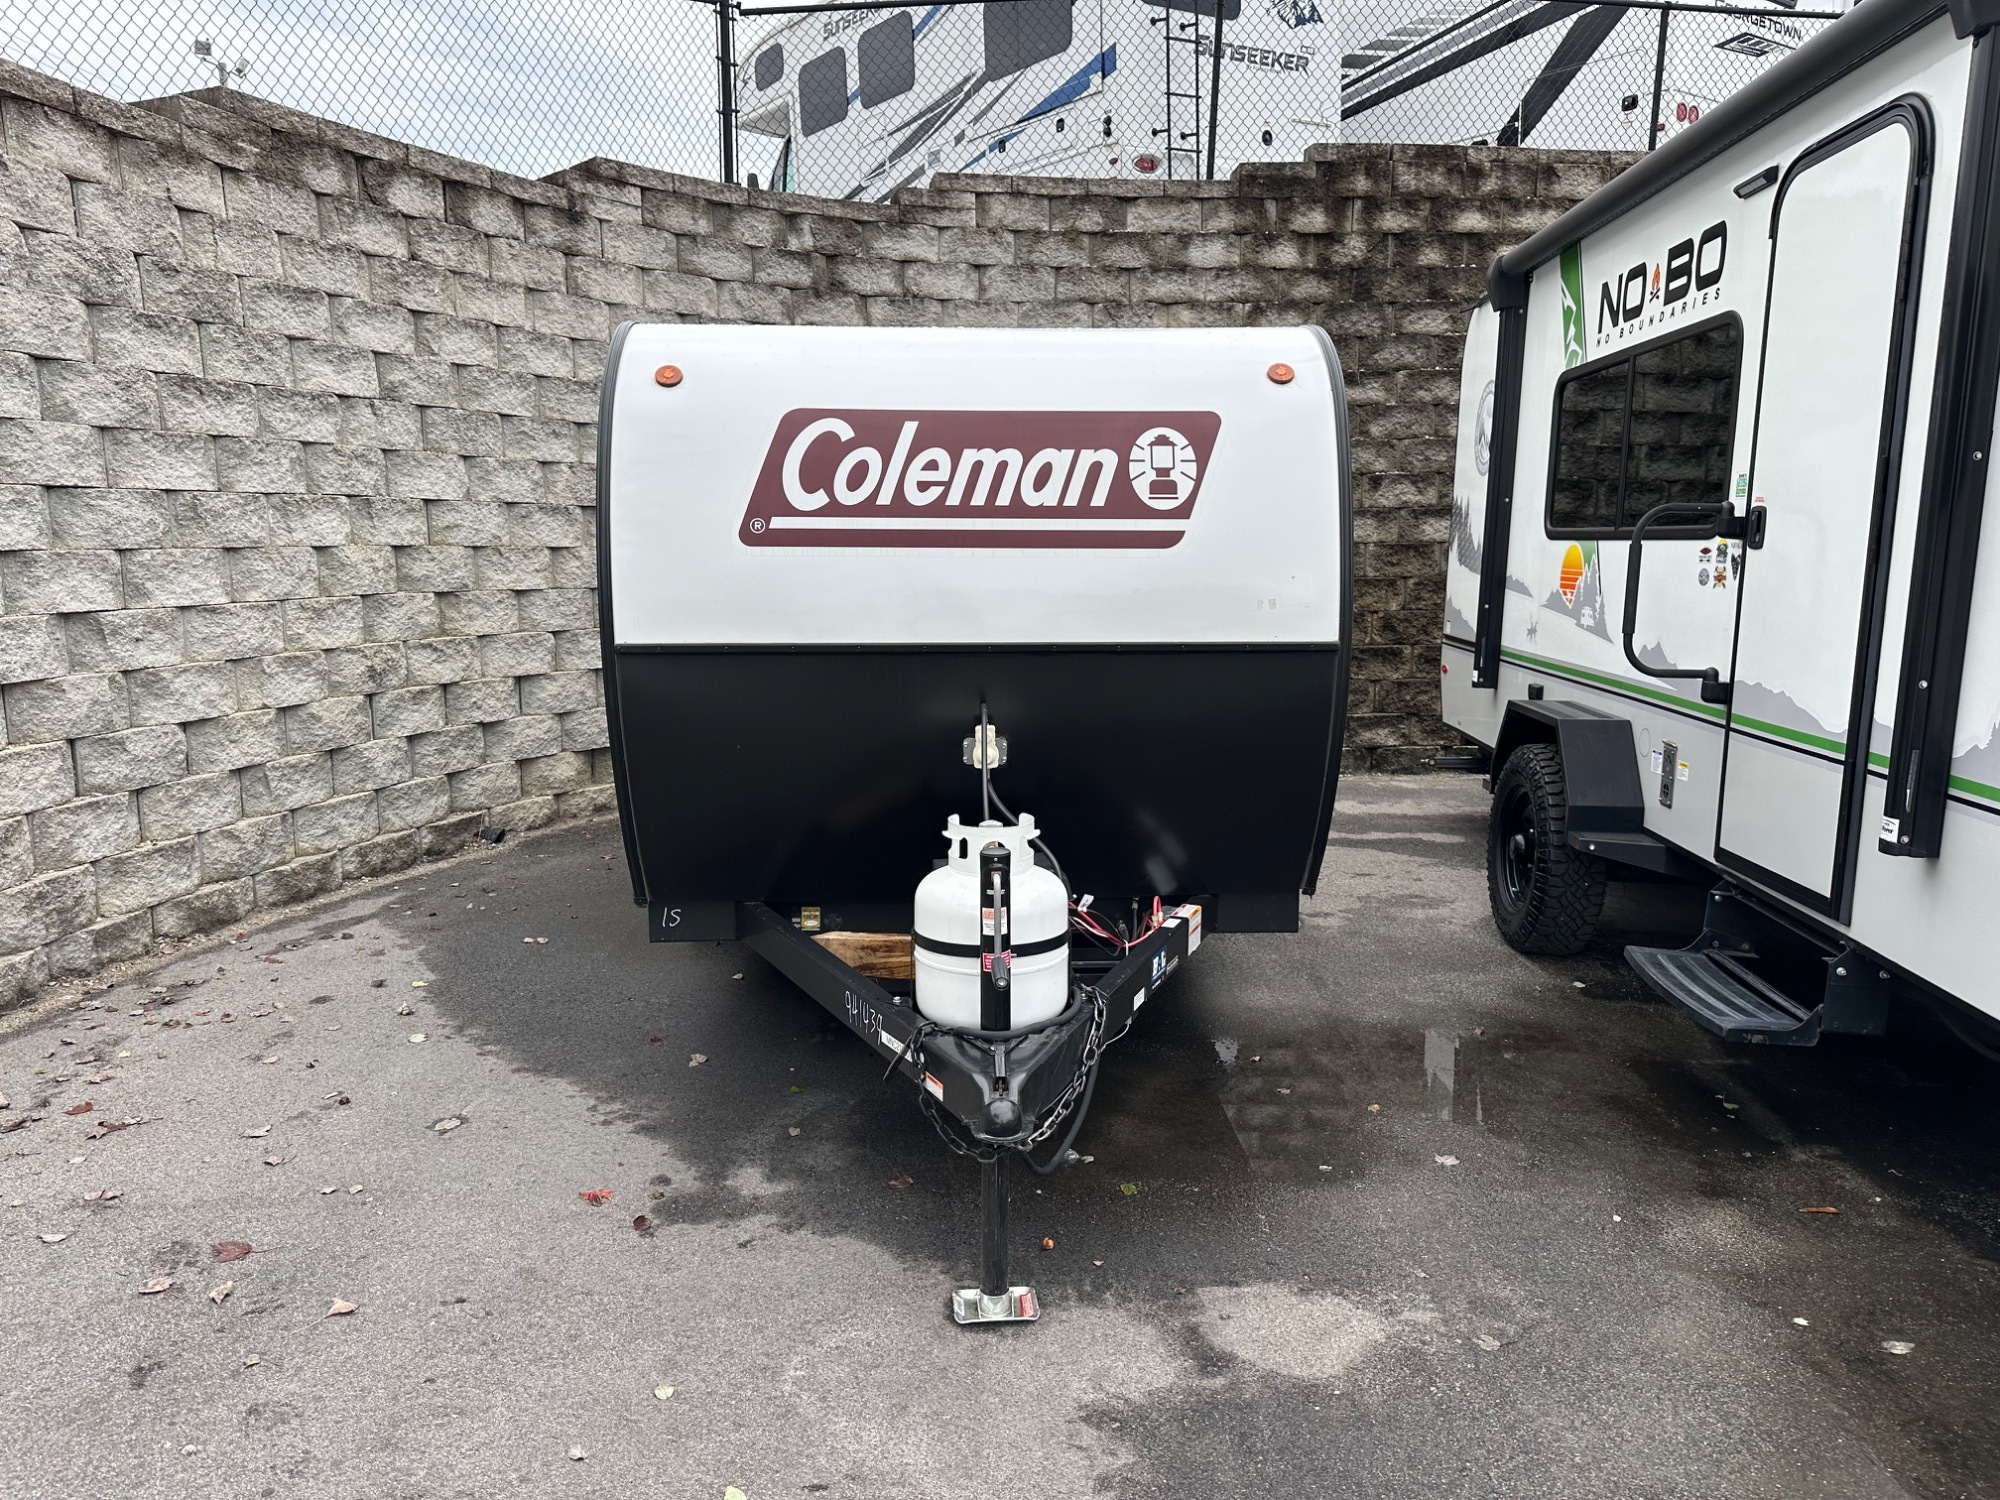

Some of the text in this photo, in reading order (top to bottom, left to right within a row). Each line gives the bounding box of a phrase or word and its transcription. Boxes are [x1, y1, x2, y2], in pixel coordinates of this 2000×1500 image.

[823, 8, 881, 41] SUNSEEK
[1715, 0, 1801, 40] RGETOWN
[1194, 34, 1310, 77] SUNSEEKER
[1619, 287, 1721, 339] BOUNDARIES
[781, 417, 1119, 512] Coleman
[844, 990, 883, 1046] 941439
